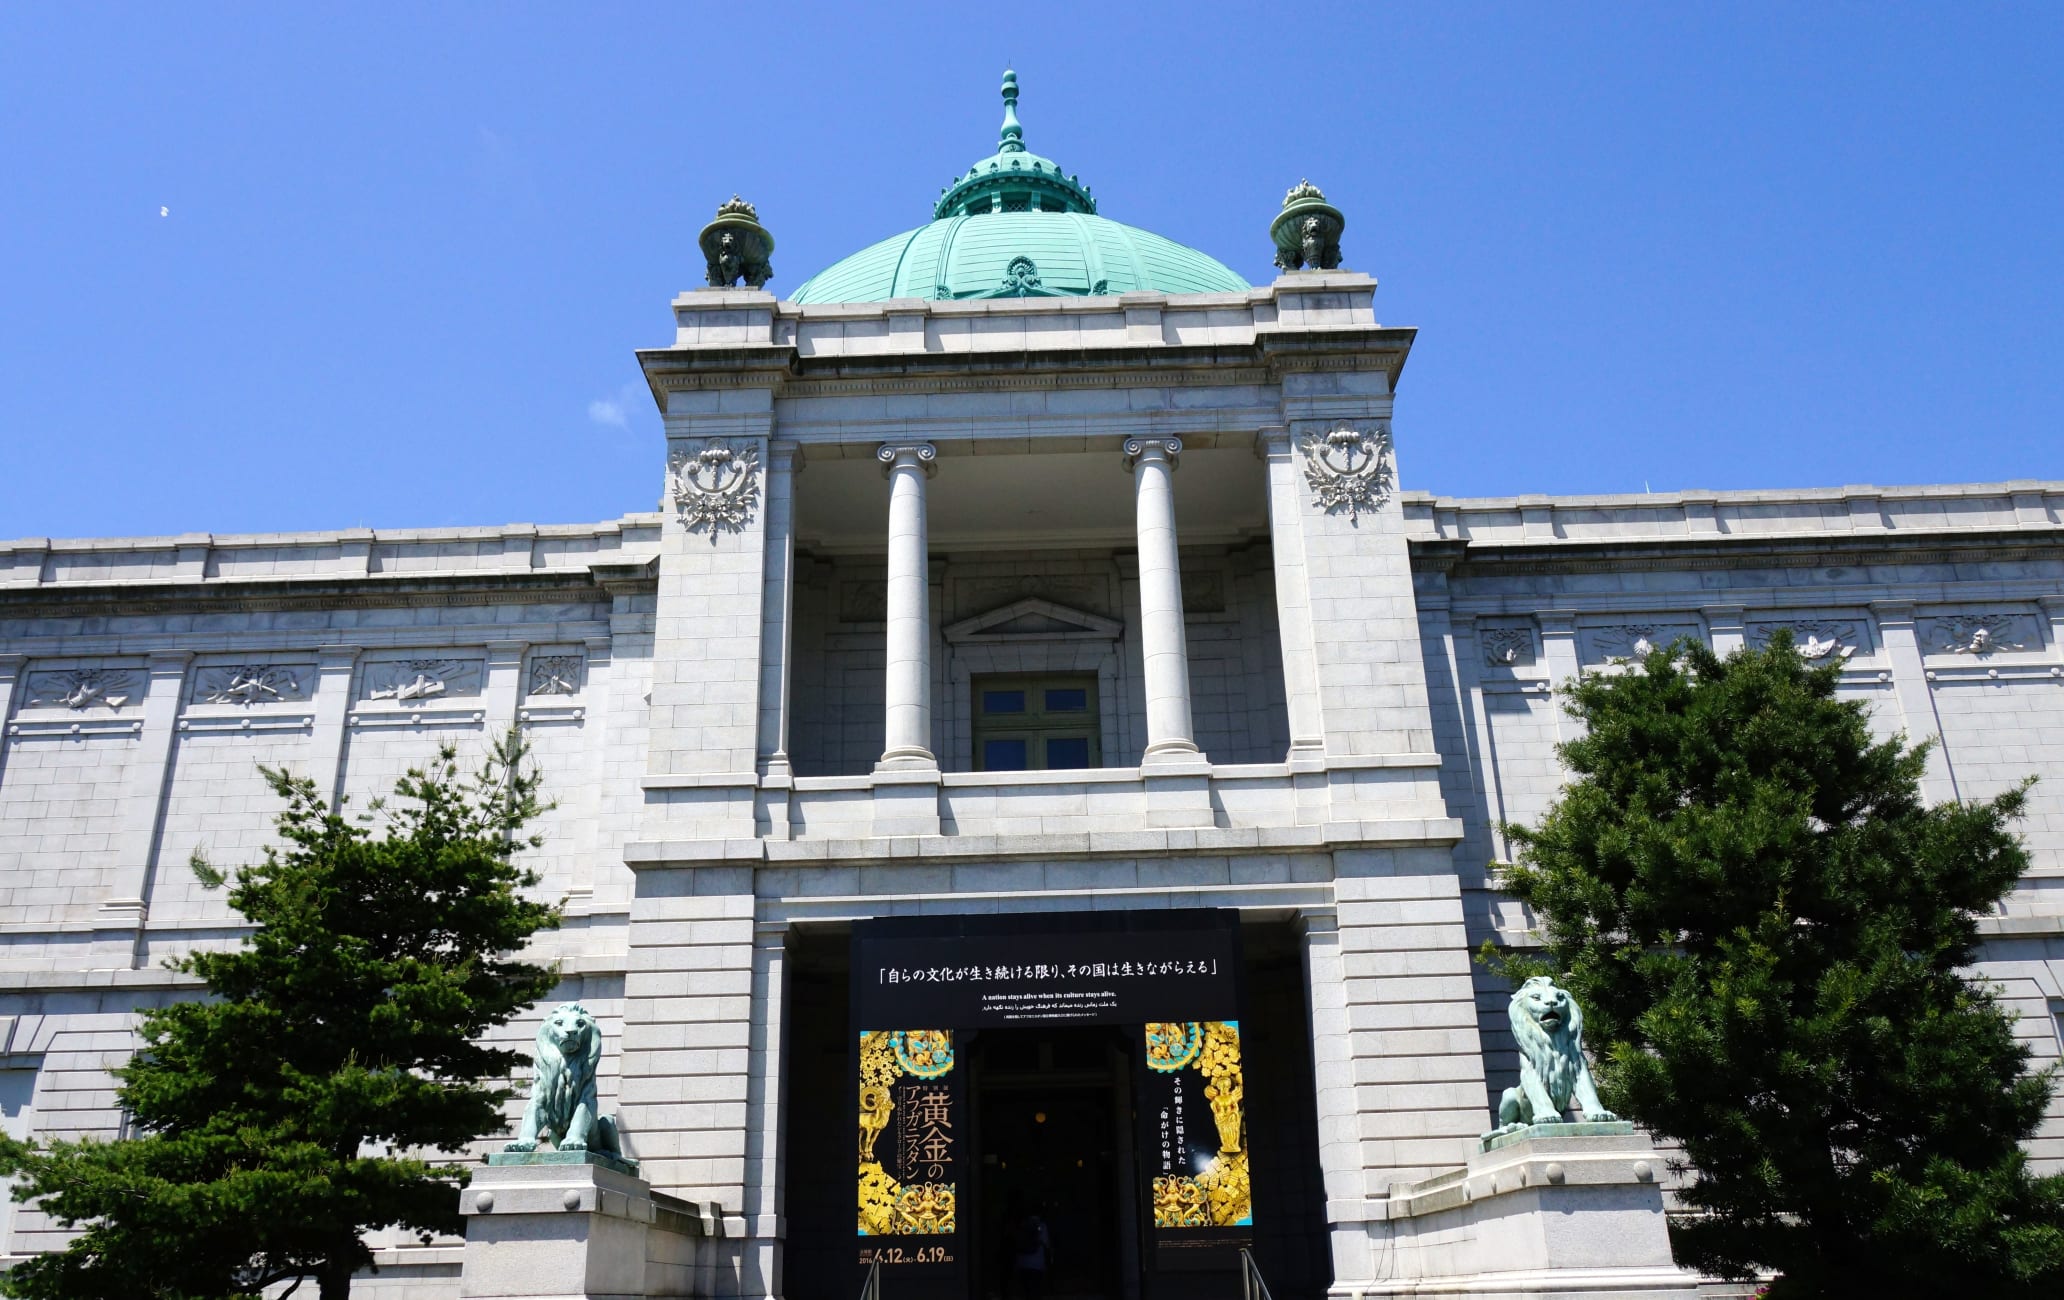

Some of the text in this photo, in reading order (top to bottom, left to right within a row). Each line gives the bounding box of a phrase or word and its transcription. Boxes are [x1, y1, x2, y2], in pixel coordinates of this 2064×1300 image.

[879, 958, 1217, 984] 「自らの文化が生き続ける限り、その国は生きながらえる」
[905, 1085, 922, 1180] アフガニスタン
[919, 1092, 954, 1179] 黄金の
[1160, 1107, 1171, 1175] 「命がけの物語」
[1174, 1077, 1186, 1165] その輝きに隠された
